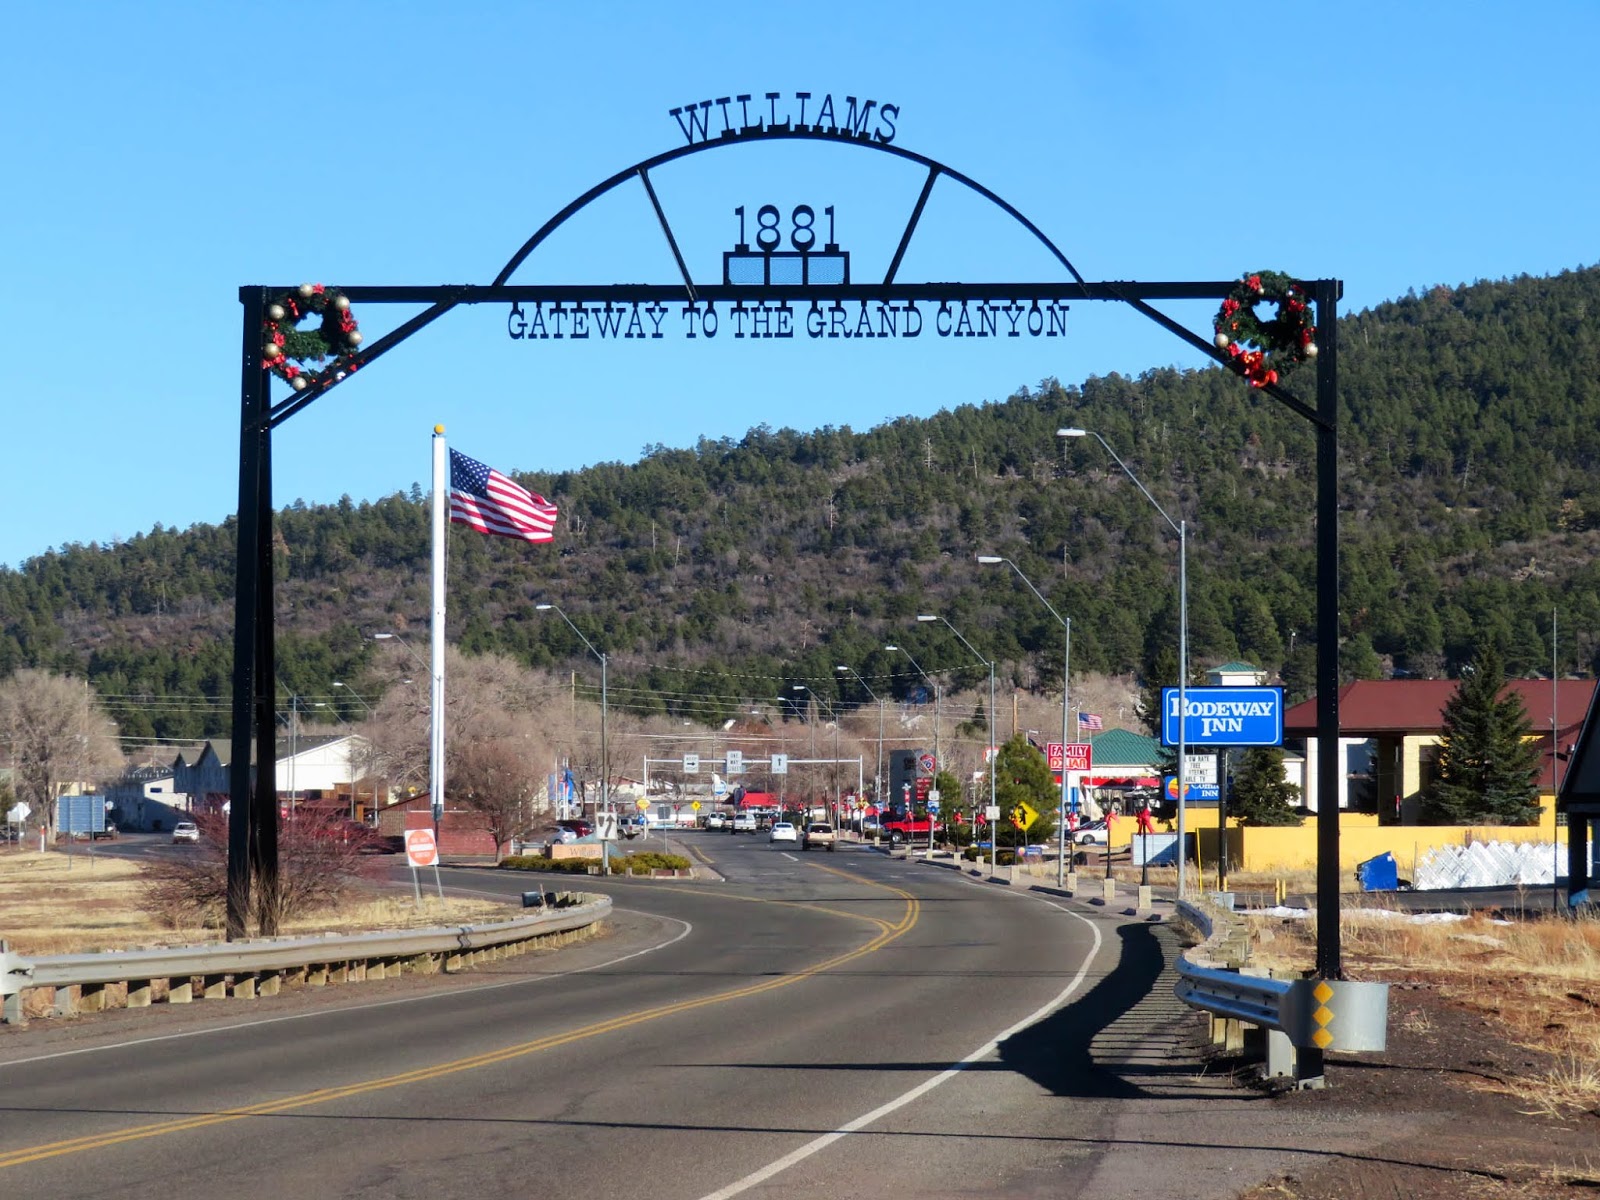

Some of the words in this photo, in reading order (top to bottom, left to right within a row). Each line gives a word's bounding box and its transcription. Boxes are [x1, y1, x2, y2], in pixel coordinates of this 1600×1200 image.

[669, 92, 900, 144] WILLIAMS
[734, 204, 840, 252] 1881
[507, 305, 668, 340] GATEWAY
[682, 305, 719, 339] TO
[730, 305, 794, 338] THE
[806, 303, 923, 339] GRAND
[936, 303, 1070, 337] CANYON
[1170, 697, 1274, 716] RODEWAY
[1201, 717, 1243, 736] INN
[1051, 745, 1087, 756] FAMILY
[1051, 757, 1087, 768] DLAR
[1201, 789, 1219, 797] INN
